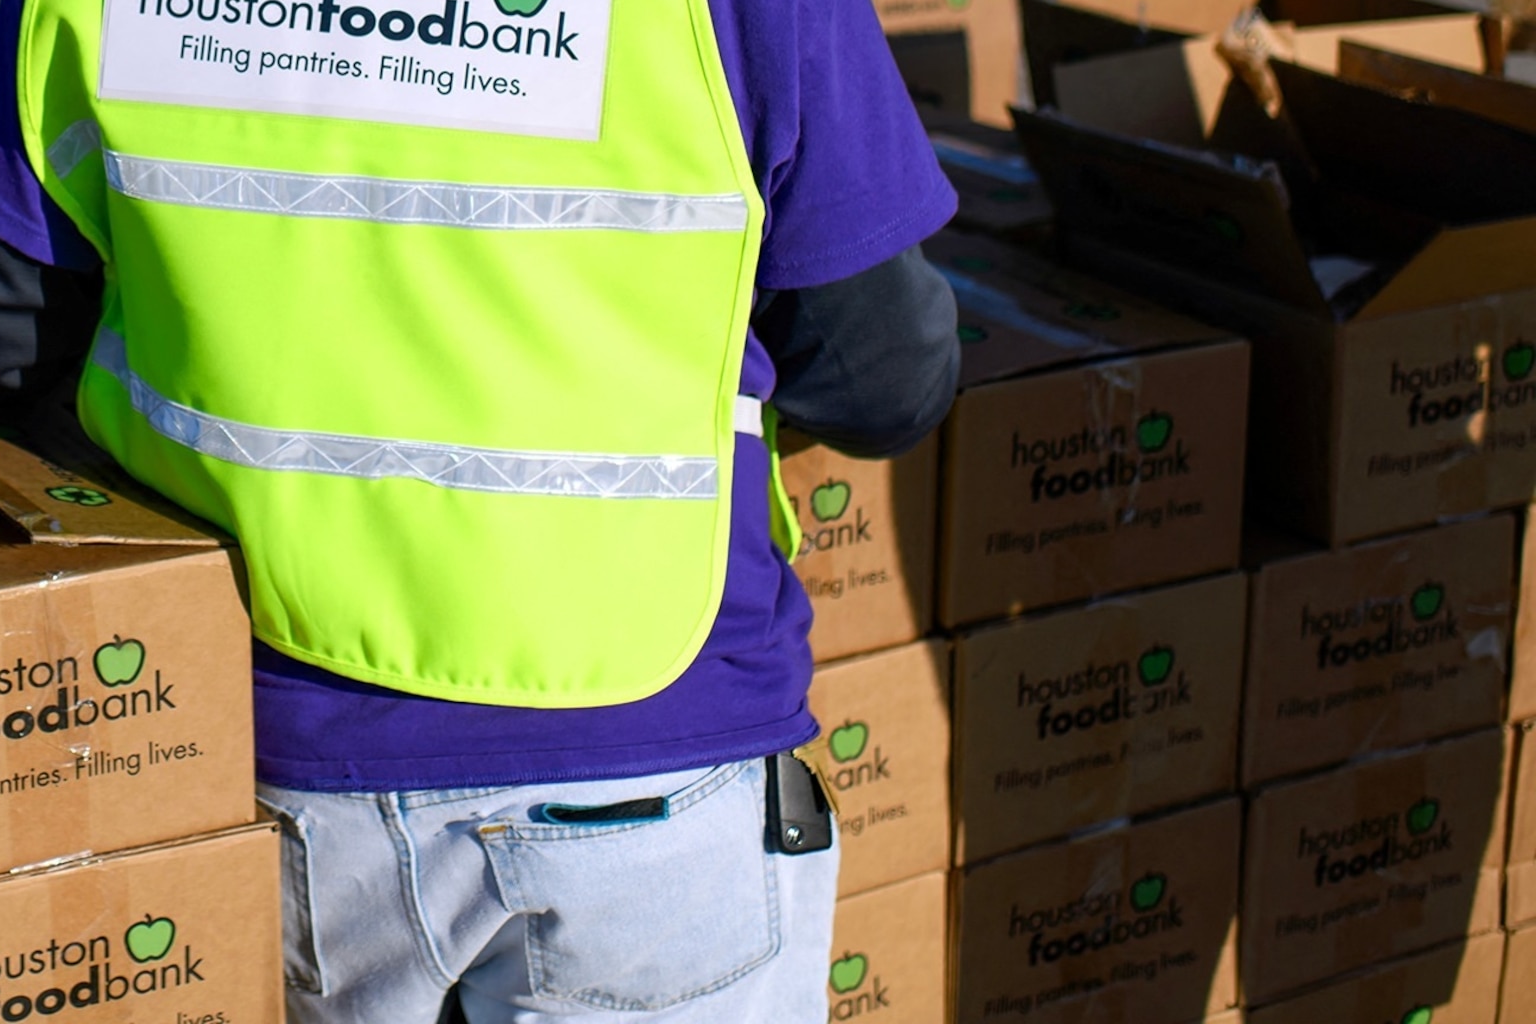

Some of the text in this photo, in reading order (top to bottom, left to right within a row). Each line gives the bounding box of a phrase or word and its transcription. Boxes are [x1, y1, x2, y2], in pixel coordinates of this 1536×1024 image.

[180, 34, 528, 98] Filling pantries. Filling lives.
[1011, 425, 1127, 468] houston
[1031, 438, 1190, 503] foodbank
[1317, 608, 1459, 669] foodbank
[1017, 660, 1130, 707] houston
[74, 750, 142, 780] Filling
[147, 741, 205, 766] lives.
[1297, 812, 1400, 859] houston
[1316, 820, 1454, 888] foodbank
[1028, 896, 1183, 967] foodbank
